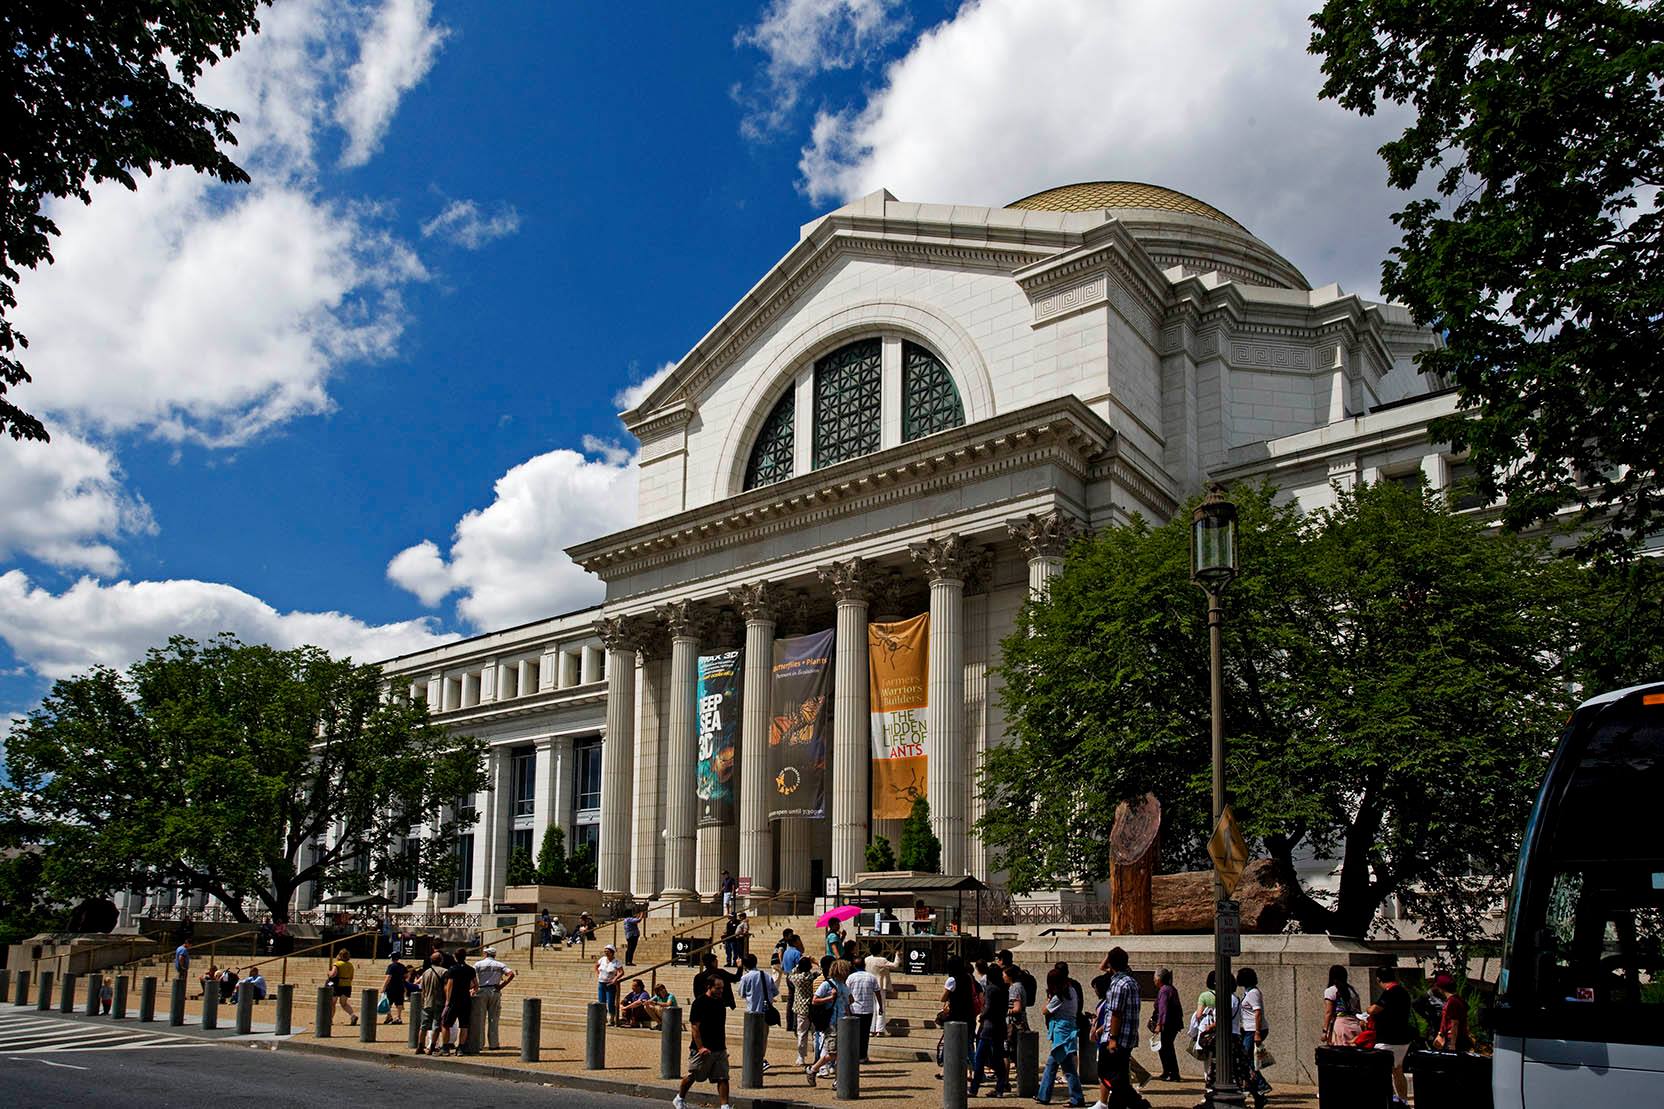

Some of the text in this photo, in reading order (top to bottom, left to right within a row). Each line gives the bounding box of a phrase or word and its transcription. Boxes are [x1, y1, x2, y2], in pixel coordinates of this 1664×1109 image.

[723, 651, 739, 659] 3D
[880, 685, 922, 697] Warriors
[700, 710, 722, 735] SEA
[890, 709, 915, 722] THE
[882, 720, 927, 736] HIDDEN
[884, 731, 928, 747] LIFE OF
[890, 744, 923, 758] ANTS
